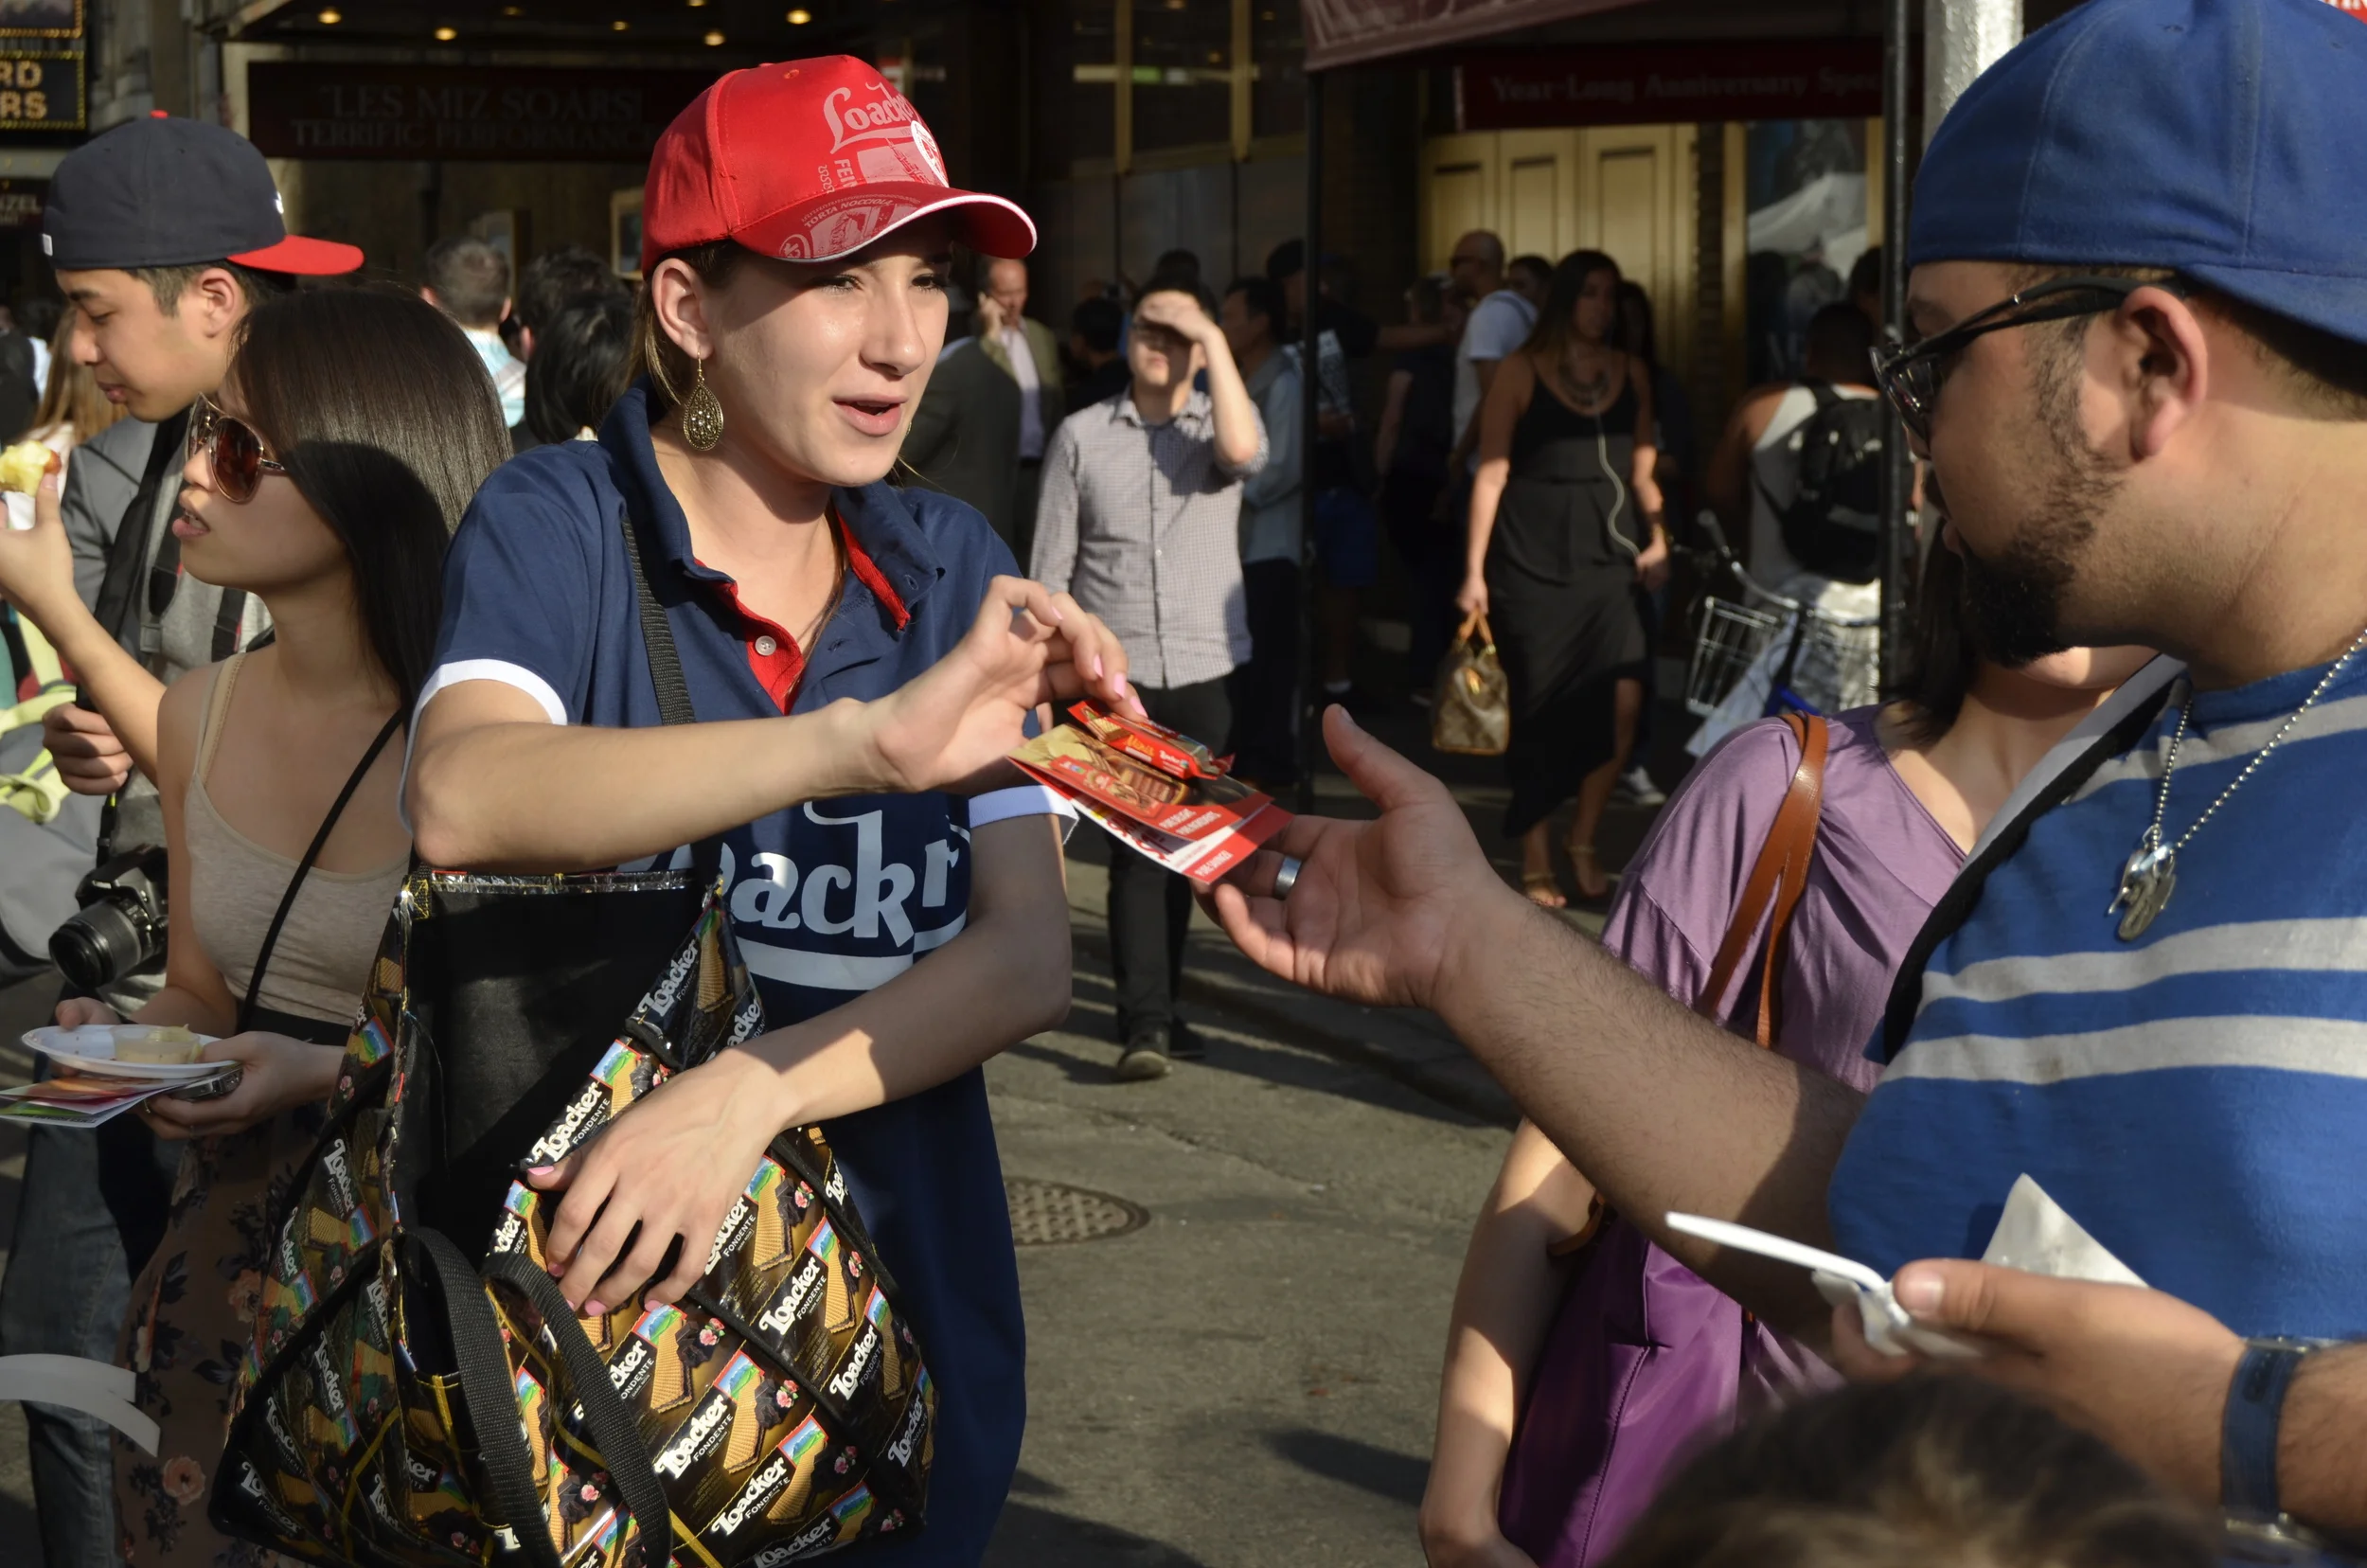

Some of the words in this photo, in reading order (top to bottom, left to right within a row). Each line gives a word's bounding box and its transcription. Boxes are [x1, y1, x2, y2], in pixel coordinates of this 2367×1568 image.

[415, 84, 491, 120] MIZ
[1645, 71, 1808, 101] Anniversary
[1818, 65, 1881, 98] Spec
[291, 117, 427, 149] TERRIFIC
[804, 207, 839, 229] TORTA
[840, 197, 896, 210] NOCCIOLA
[636, 938, 700, 1018] Loacker
[531, 1081, 604, 1164] Loacker
[572, 1097, 611, 1146] FONDENTE
[323, 1138, 356, 1213] Loacker
[328, 1177, 346, 1220] FONDENTE
[513, 1228, 528, 1255] DENTE
[722, 1214, 756, 1258] FONDENTE
[758, 1256, 821, 1336] Loacker
[796, 1274, 828, 1321] FONDENTE
[313, 1329, 346, 1413] Loacker
[621, 1357, 655, 1400] ONDENTE
[829, 1324, 878, 1401] Loacker
[654, 1394, 728, 1480] Loacker
[693, 1414, 734, 1462] FONDENTE
[887, 1393, 924, 1468] Loacker
[710, 1456, 788, 1537] Loacker
[744, 1476, 791, 1521] FONDENTE
[754, 1517, 832, 1568] Loacker
